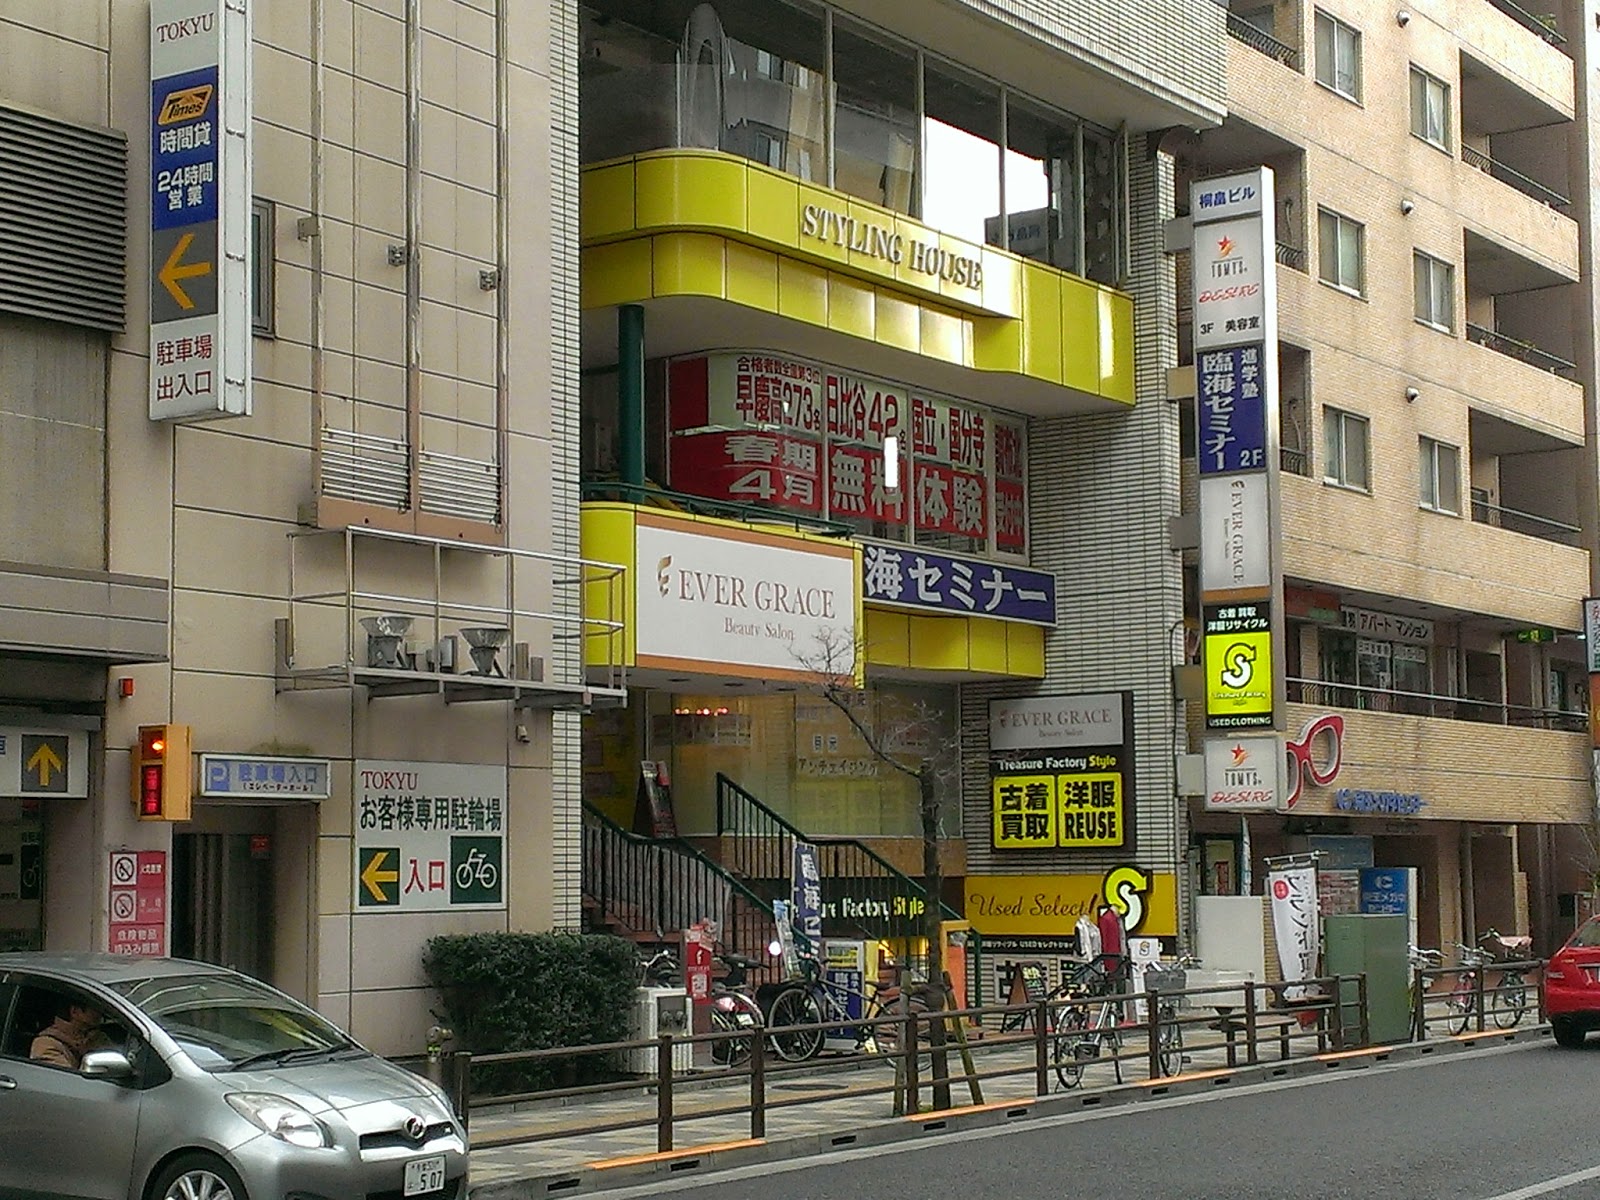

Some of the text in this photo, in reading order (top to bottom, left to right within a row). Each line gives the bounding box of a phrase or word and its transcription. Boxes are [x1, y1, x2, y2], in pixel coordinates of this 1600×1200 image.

[157, 13, 214, 43] TOKYU
[166, 92, 208, 120] Times
[160, 121, 211, 154] 時間貸
[158, 162, 213, 192] 24時間
[168, 185, 203, 210] 営業
[803, 203, 982, 291] STYLING HOUSE
[1200, 315, 1260, 335] 3F 美容室
[156, 334, 213, 367] 駐車場
[156, 370, 212, 402] 出入口
[1202, 351, 1236, 470] 臨海セミナー
[724, 434, 816, 475] 春期
[1240, 448, 1263, 467] 2F
[729, 469, 813, 504] 4月
[678, 569, 836, 619] EVER GRACE
[865, 546, 1048, 612] 海セミナー
[724, 617, 795, 641] Beauty Salon
[1012, 708, 1113, 728] EVER GRACE
[1000, 754, 1117, 771] Treasure Factory Style
[361, 770, 418, 791] TOKYU
[1000, 781, 1115, 811] 古着 洋服
[360, 794, 503, 833] お客様専用駐輪場
[1001, 811, 1116, 841] 買取 REUSE
[405, 858, 446, 895] 入口
[970, 893, 1022, 916] Used
